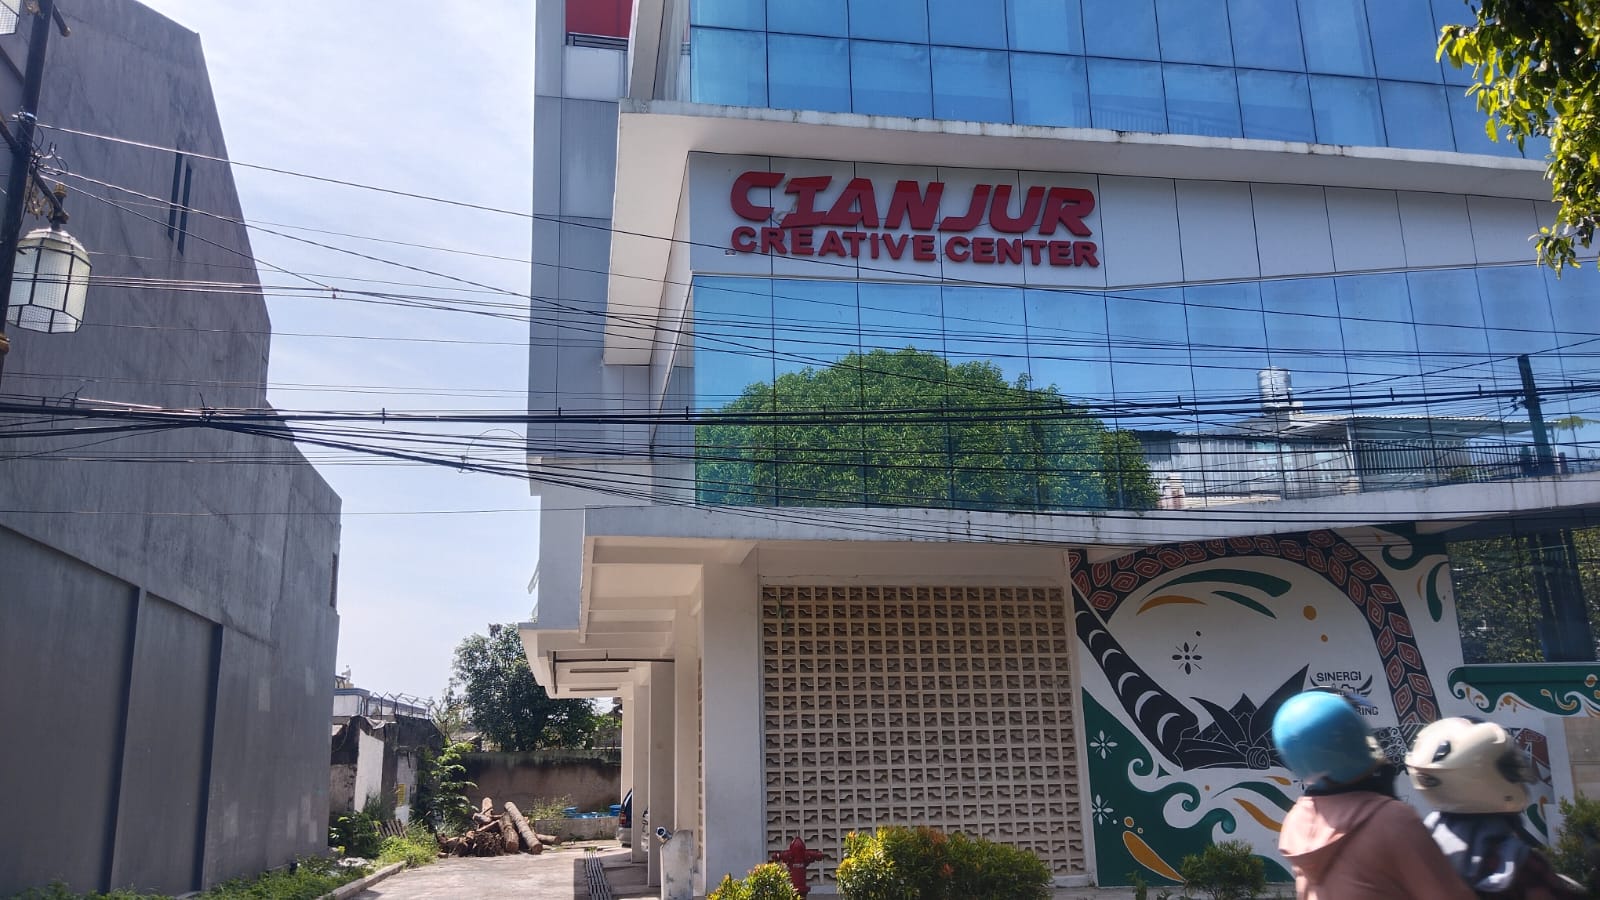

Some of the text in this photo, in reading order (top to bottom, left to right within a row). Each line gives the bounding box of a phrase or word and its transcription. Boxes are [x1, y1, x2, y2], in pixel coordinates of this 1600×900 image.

[730, 171, 1095, 237] CIANJUR
[731, 225, 1100, 268] CREATIVE CENTER
[1316, 671, 1362, 682] SINERGI
